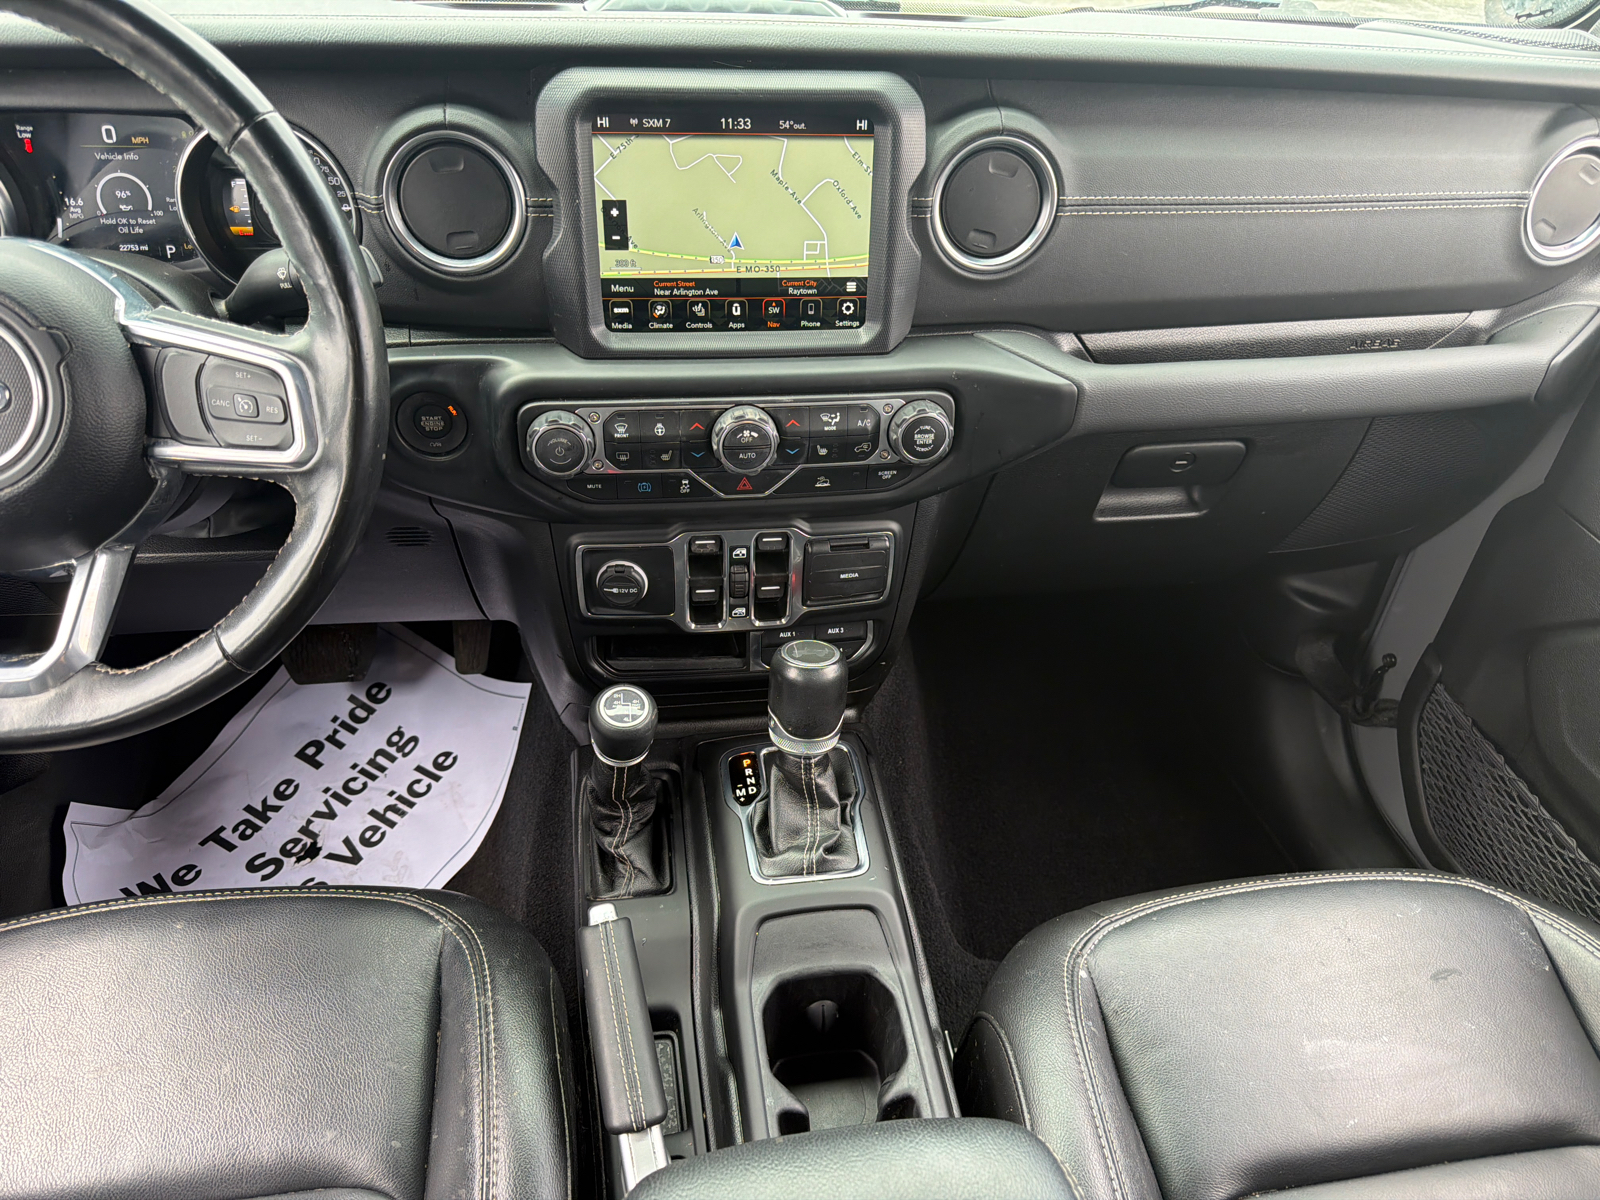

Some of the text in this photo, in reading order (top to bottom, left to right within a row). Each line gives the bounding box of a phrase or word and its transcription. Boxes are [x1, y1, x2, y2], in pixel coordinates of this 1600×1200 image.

[597, 116, 609, 128] HI
[642, 118, 671, 128] SXM 7
[720, 118, 752, 130] 11:33
[856, 120, 868, 130] HI
[102, 125, 116, 143] 0
[132, 136, 149, 144] MPH
[610, 138, 634, 160] E 75th
[94, 152, 138, 160] Vehicle Info
[852, 151, 864, 166] Elm
[328, 176, 340, 186] 50
[770, 169, 802, 205] Maple Ave
[116, 190, 131, 198] 96%
[65, 198, 84, 206] 16.6
[832, 180, 862, 219] Oxford Ave
[692, 208, 720, 240] Arlington
[166, 245, 176, 258] P
[805, 280, 817, 288] City
[672, 288, 704, 296] Arlington
[788, 288, 818, 296] Raytown
[212, 399, 230, 407] CANC
[742, 759, 751, 768] P
[744, 768, 754, 776] R
[746, 776, 756, 786] N
[119, 682, 393, 897] We Take Pride
[736, 788, 746, 796] M
[748, 786, 757, 794] D
[244, 724, 420, 882] Servicing
[322, 750, 459, 868] Vehicle
